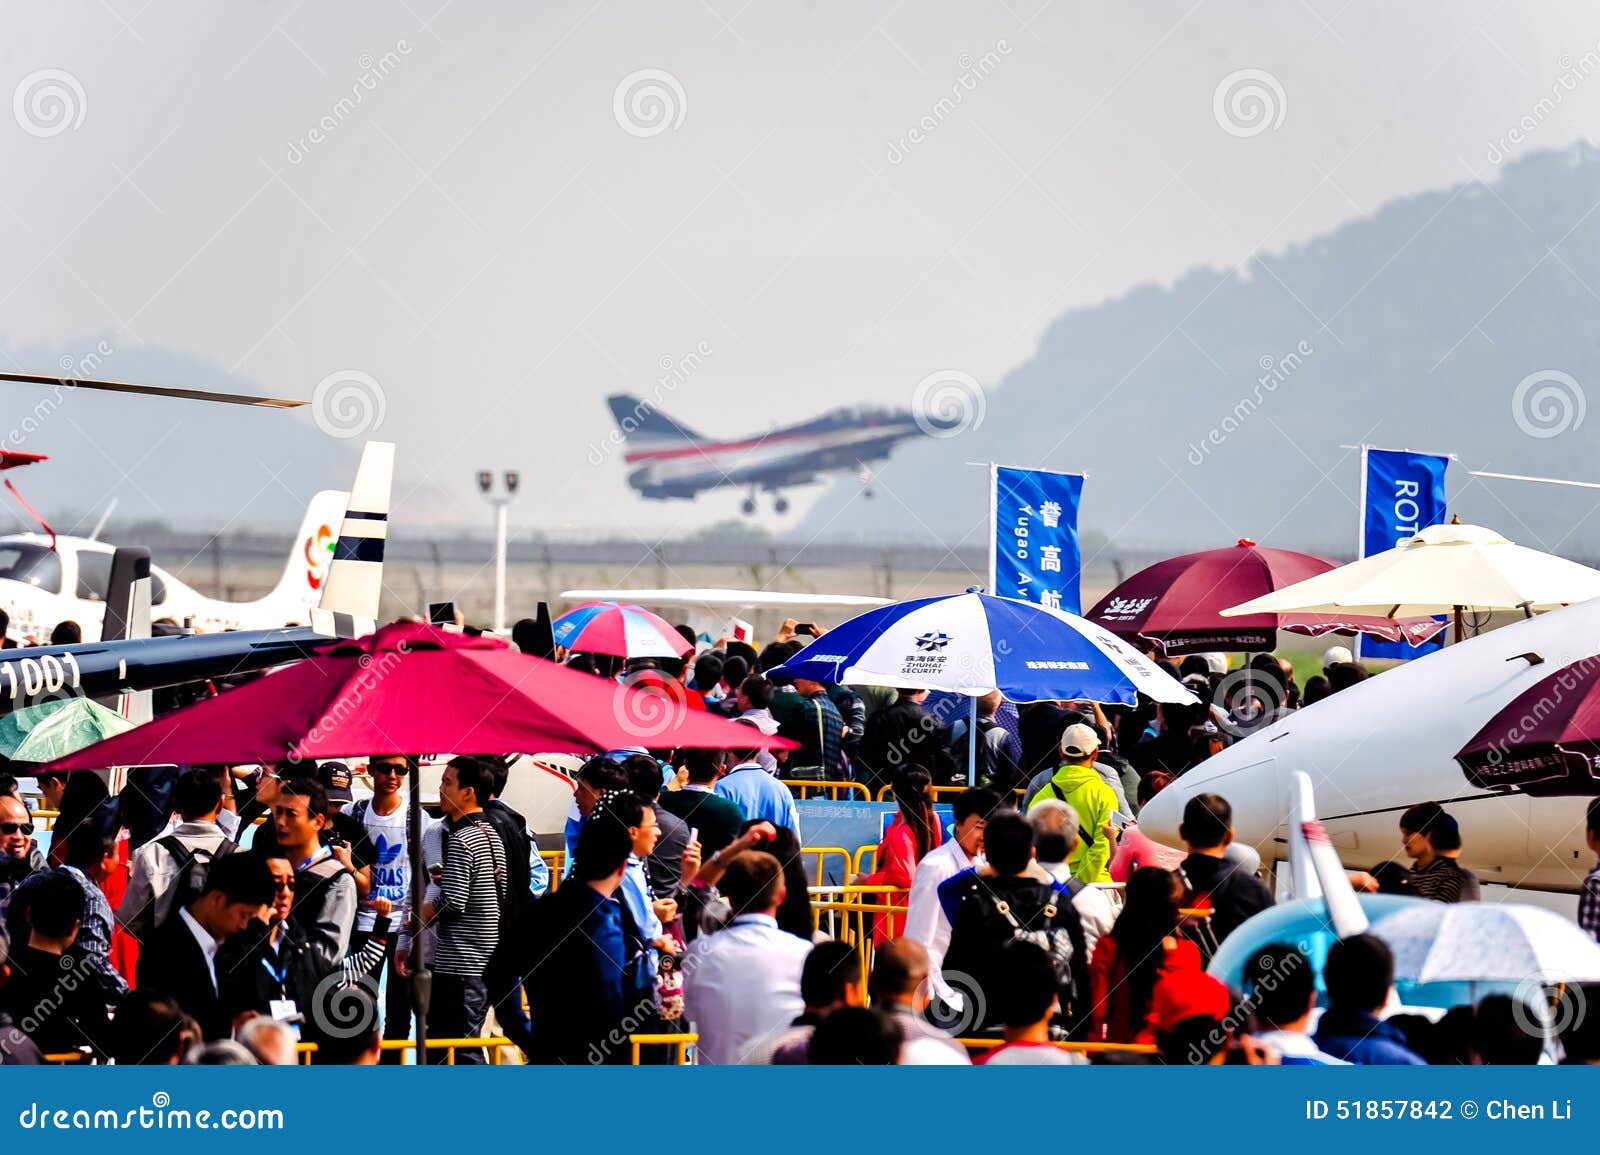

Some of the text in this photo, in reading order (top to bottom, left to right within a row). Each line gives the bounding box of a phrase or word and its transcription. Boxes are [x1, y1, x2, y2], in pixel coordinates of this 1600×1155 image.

[1014, 504, 1032, 560] Yugao
[0, 651, 80, 699] 1001
[905, 655, 948, 663] 珠海保安
[378, 867, 404, 886] DAS
